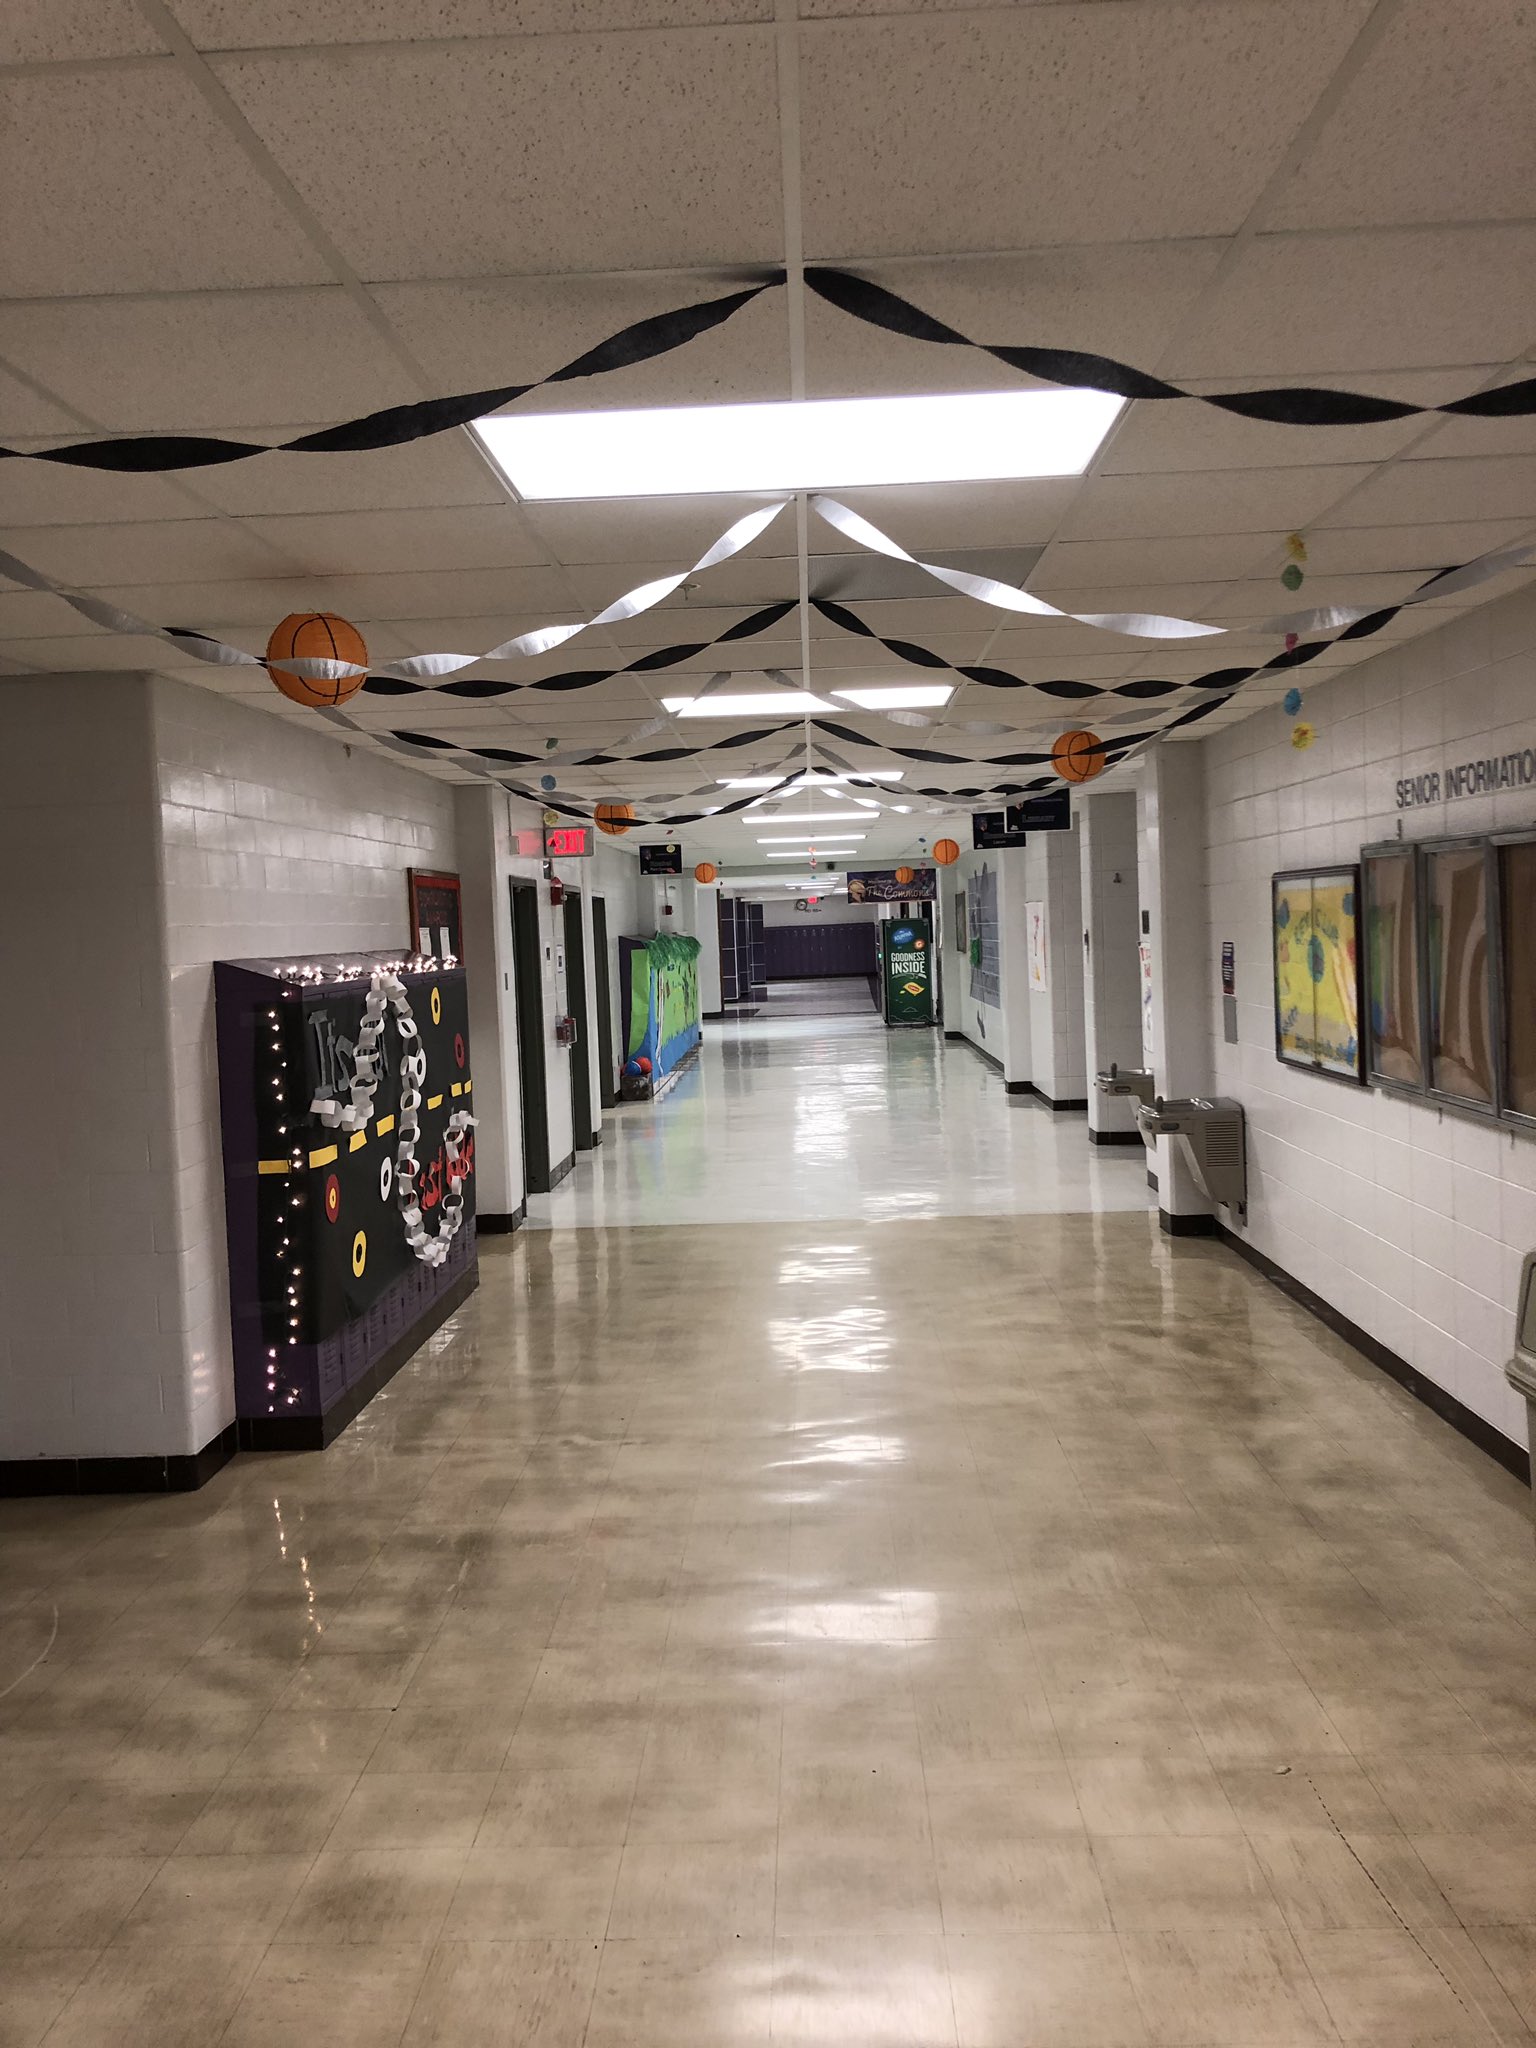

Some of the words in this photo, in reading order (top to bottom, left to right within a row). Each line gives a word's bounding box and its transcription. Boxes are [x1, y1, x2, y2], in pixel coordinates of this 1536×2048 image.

[1396, 772, 1440, 808] SENIOR
[1445, 748, 1536, 799] INFORMATIO
[553, 829, 586, 855] EXIT
[891, 952, 925, 962] GOODNESS
[891, 961, 926, 975] INSIDE
